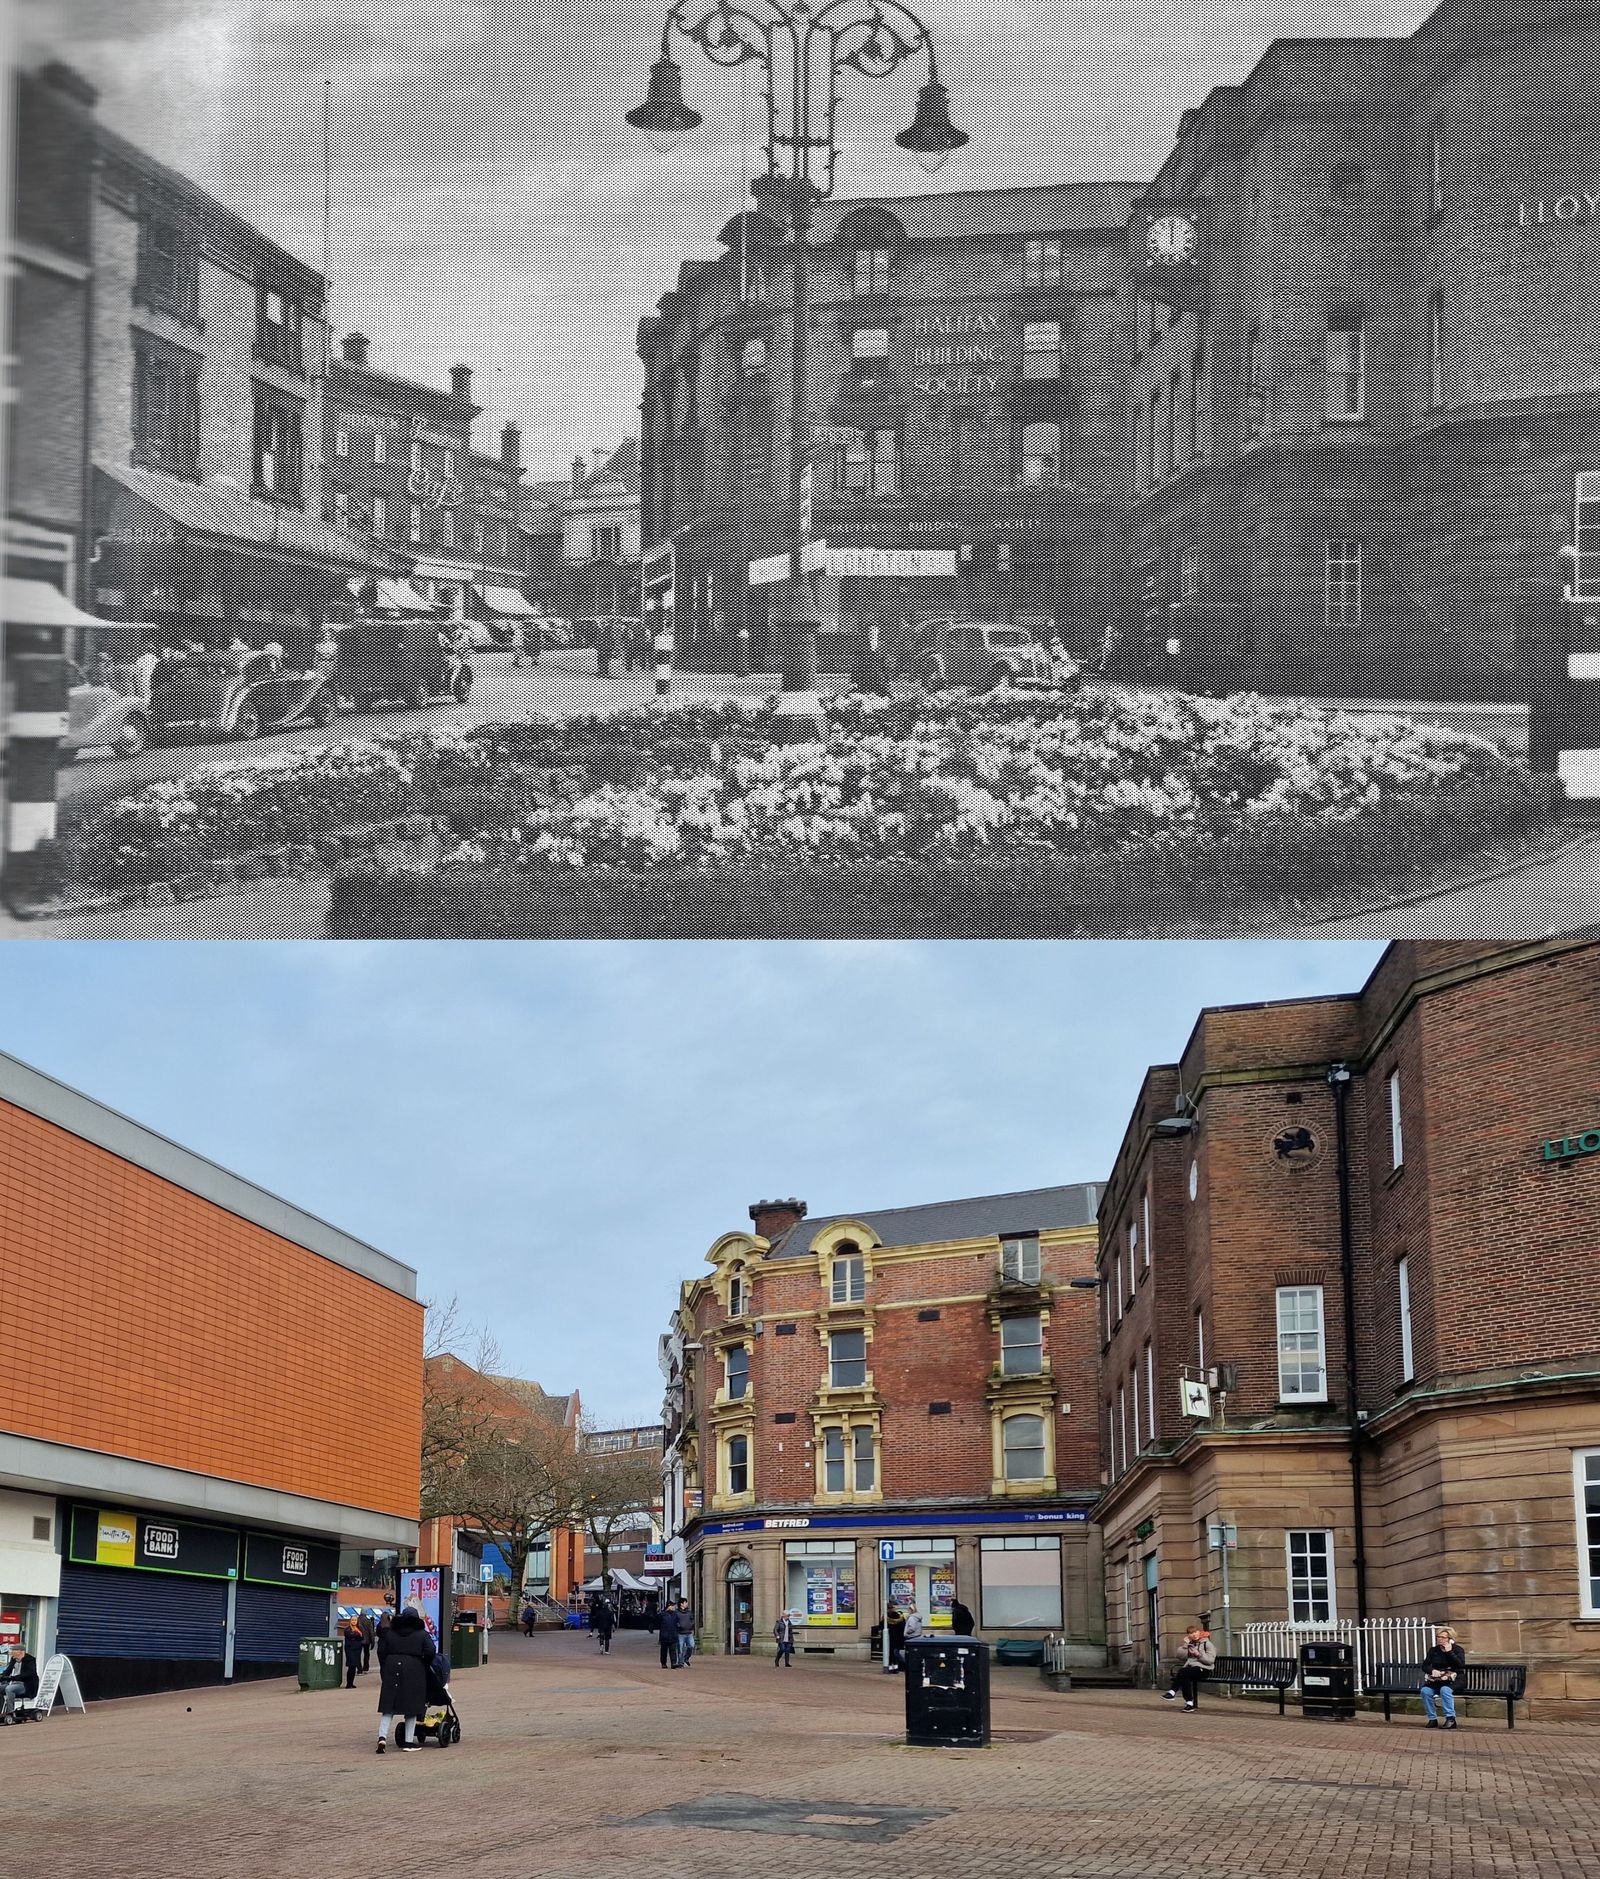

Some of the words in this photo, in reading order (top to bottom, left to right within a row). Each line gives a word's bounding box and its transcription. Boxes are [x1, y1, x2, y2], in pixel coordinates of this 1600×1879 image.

[914, 313, 1000, 335] HALIFAX
[914, 343, 1004, 366] BUILDING
[913, 374, 1000, 396] SOCIETY
[765, 1518, 810, 1528] BETFRED
[150, 1530, 174, 1543] FOOD
[149, 1540, 173, 1554] BANK
[286, 1551, 304, 1562] FOOD
[286, 1560, 304, 1571] BANK
[410, 1577, 439, 1601] £1.98
